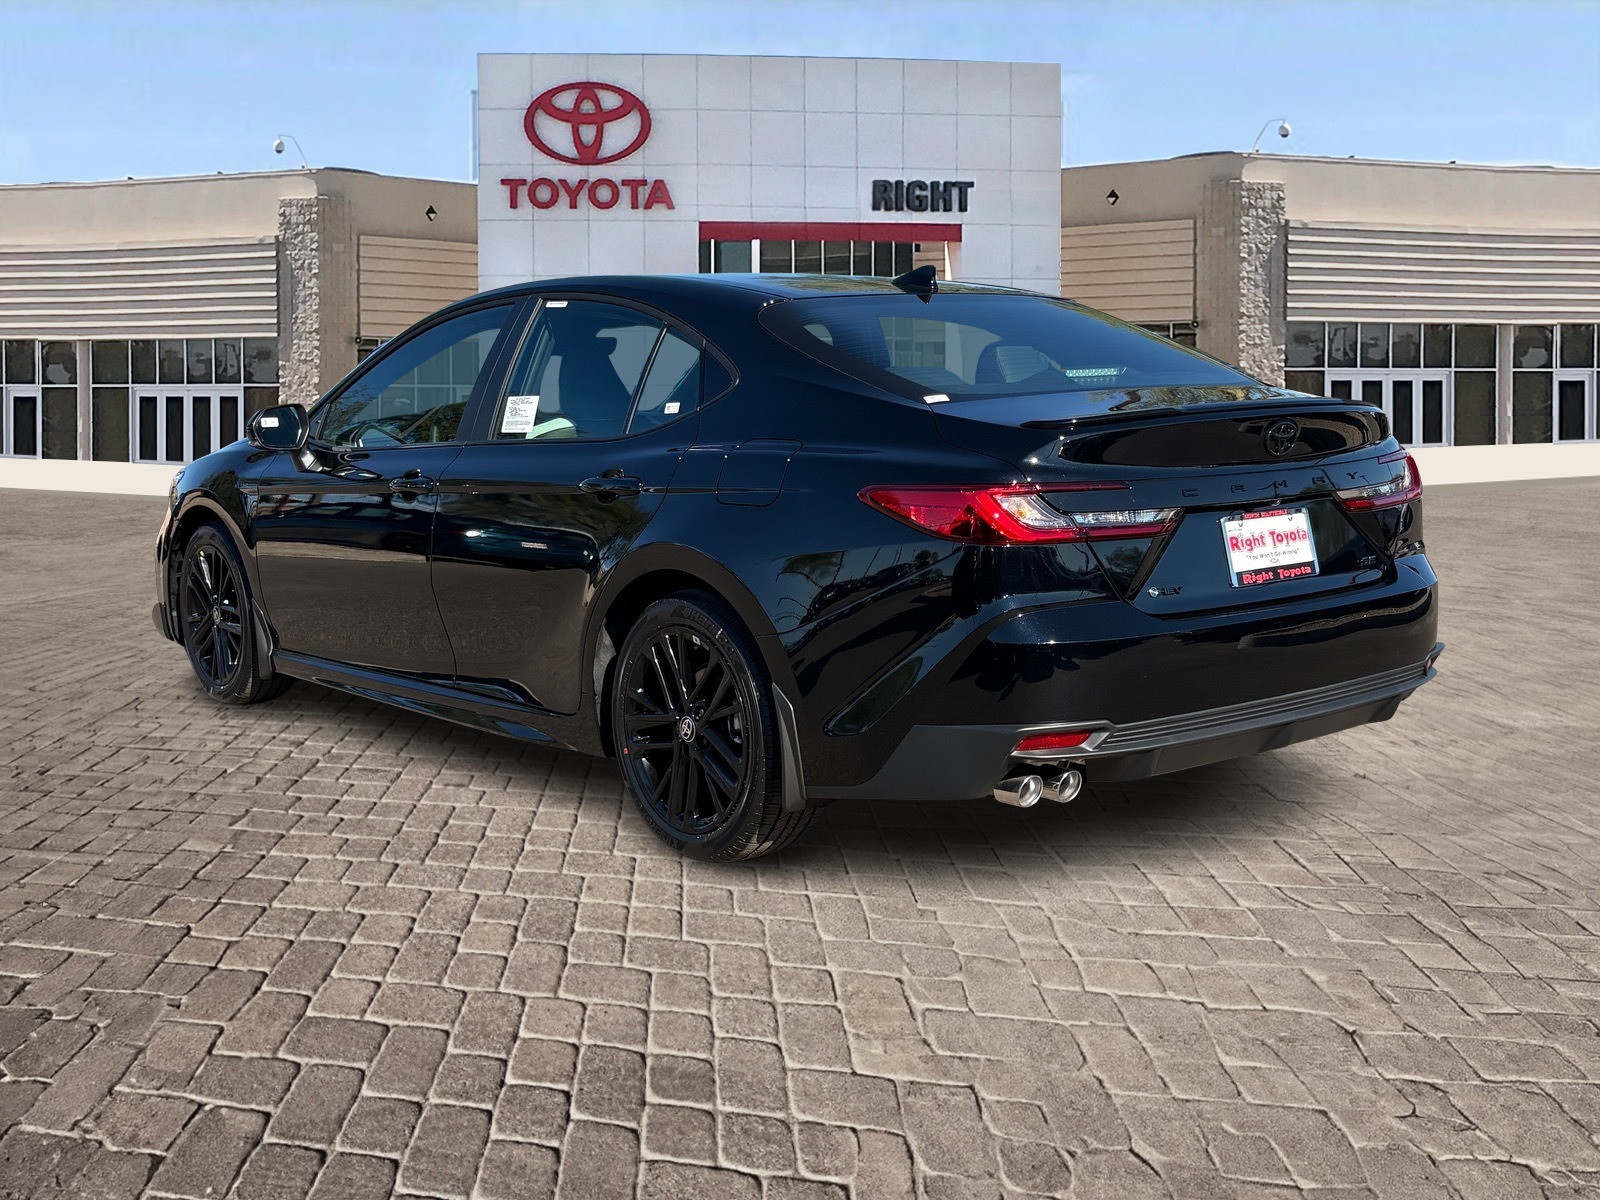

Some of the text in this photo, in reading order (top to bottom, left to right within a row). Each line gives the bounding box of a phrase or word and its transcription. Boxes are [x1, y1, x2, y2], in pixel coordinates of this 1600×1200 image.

[501, 178, 675, 210] TOYOTA
[871, 179, 975, 213] RIGHT
[1228, 528, 1309, 552] Right Toyota
[1242, 566, 1312, 584] Right Toyota
